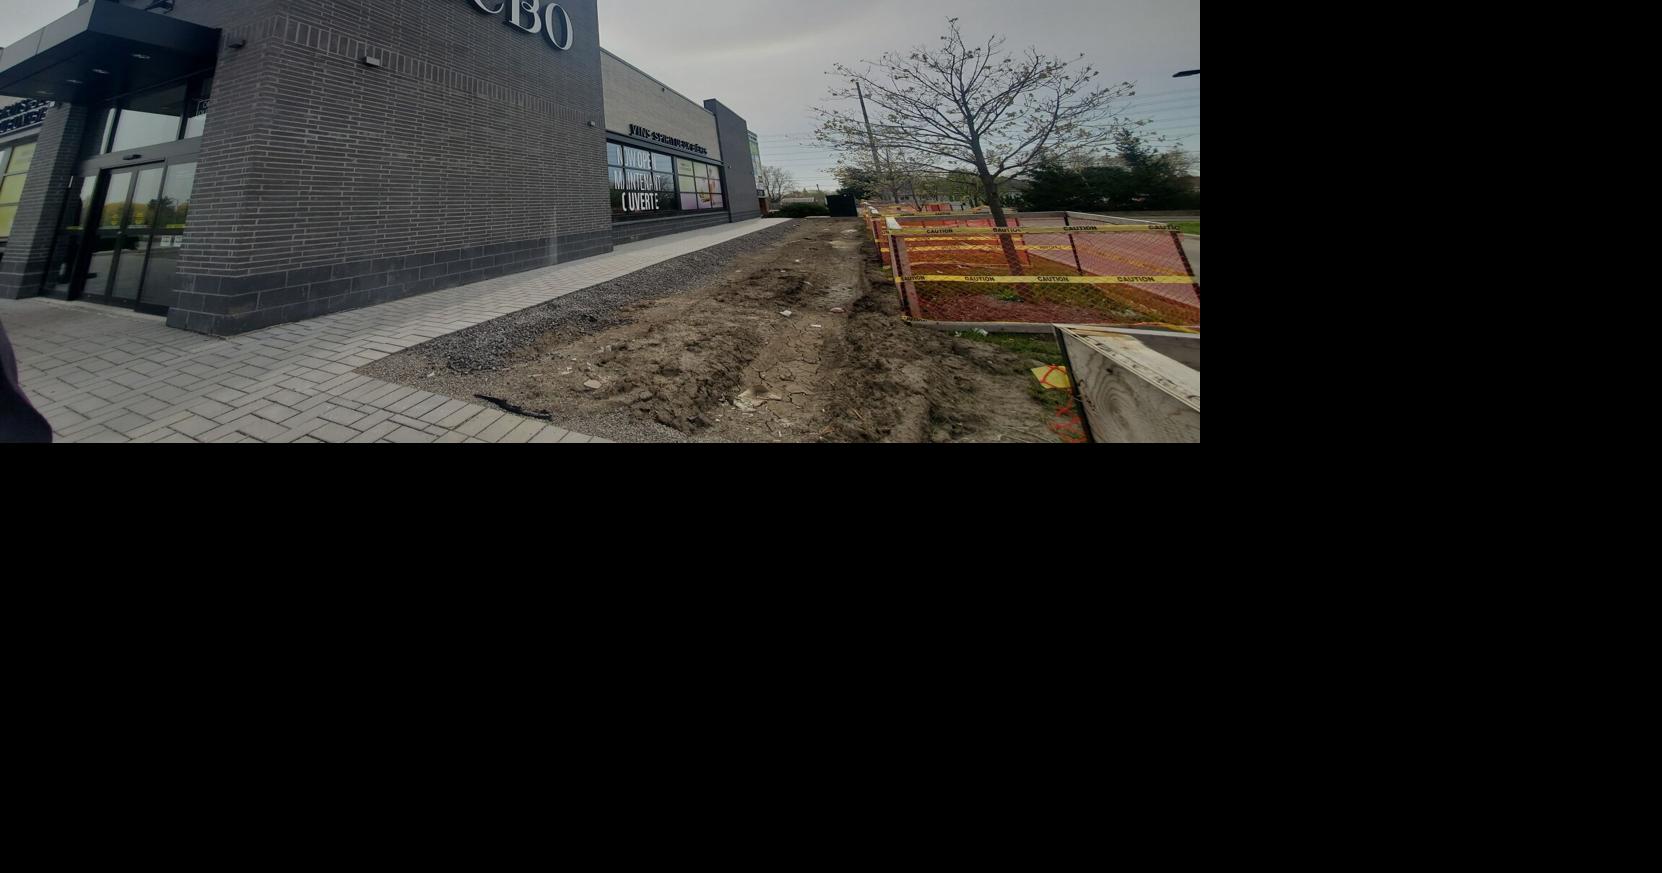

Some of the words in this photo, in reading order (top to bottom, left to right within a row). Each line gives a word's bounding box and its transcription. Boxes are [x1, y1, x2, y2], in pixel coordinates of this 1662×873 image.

[474, 0, 573, 50] BO
[637, 150, 657, 170] OPEN
[614, 170, 661, 191] MAINTENANT
